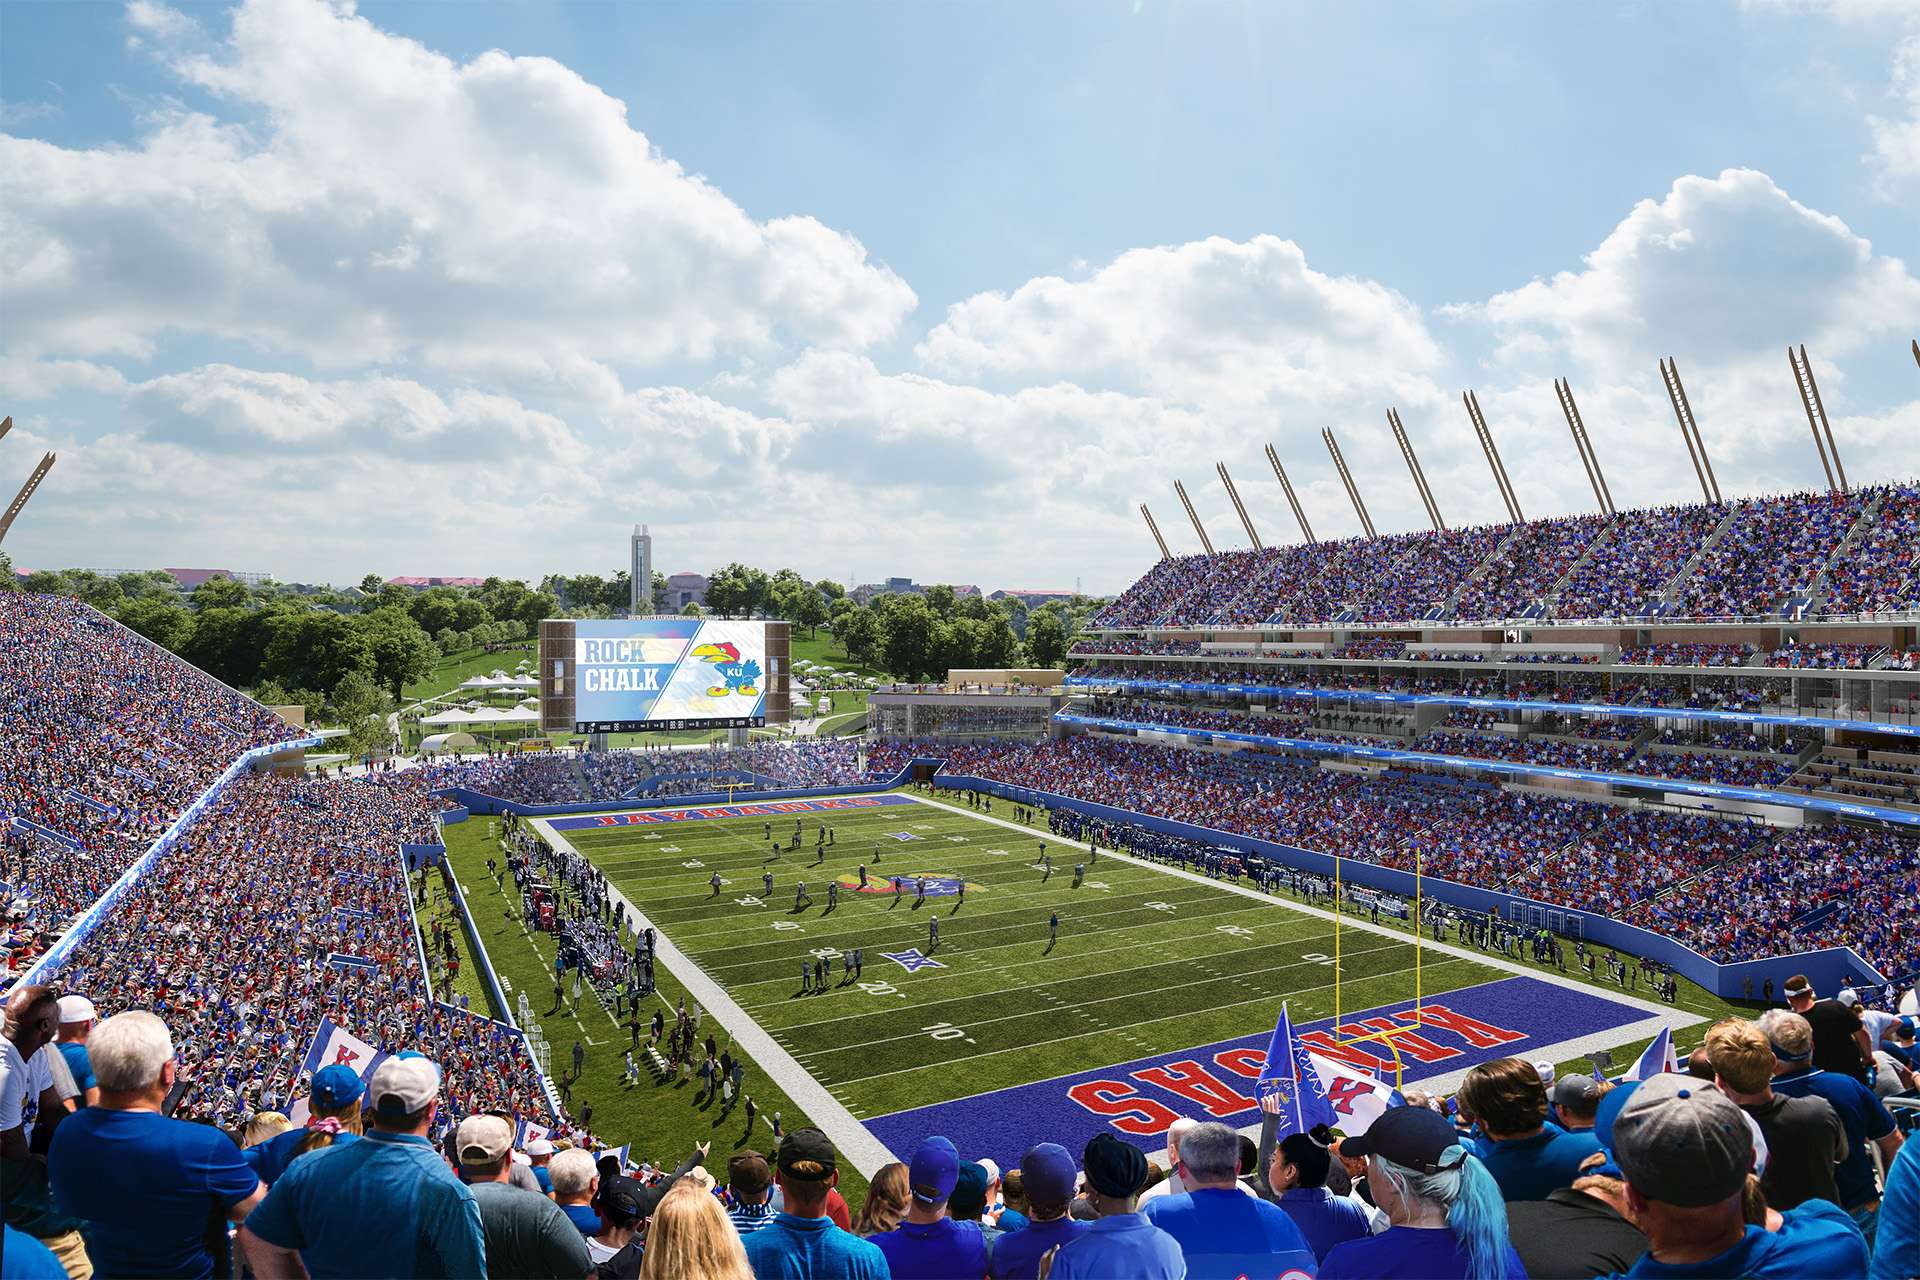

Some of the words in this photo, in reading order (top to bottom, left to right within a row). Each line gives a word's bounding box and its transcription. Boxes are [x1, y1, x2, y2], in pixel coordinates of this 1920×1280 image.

[584, 640, 646, 663] ROCK
[585, 668, 659, 692] CHALK
[727, 667, 743, 677] KU
[598, 798, 882, 827] JAYHAWKS
[856, 980, 898, 996] 20
[920, 1022, 966, 1041] 10
